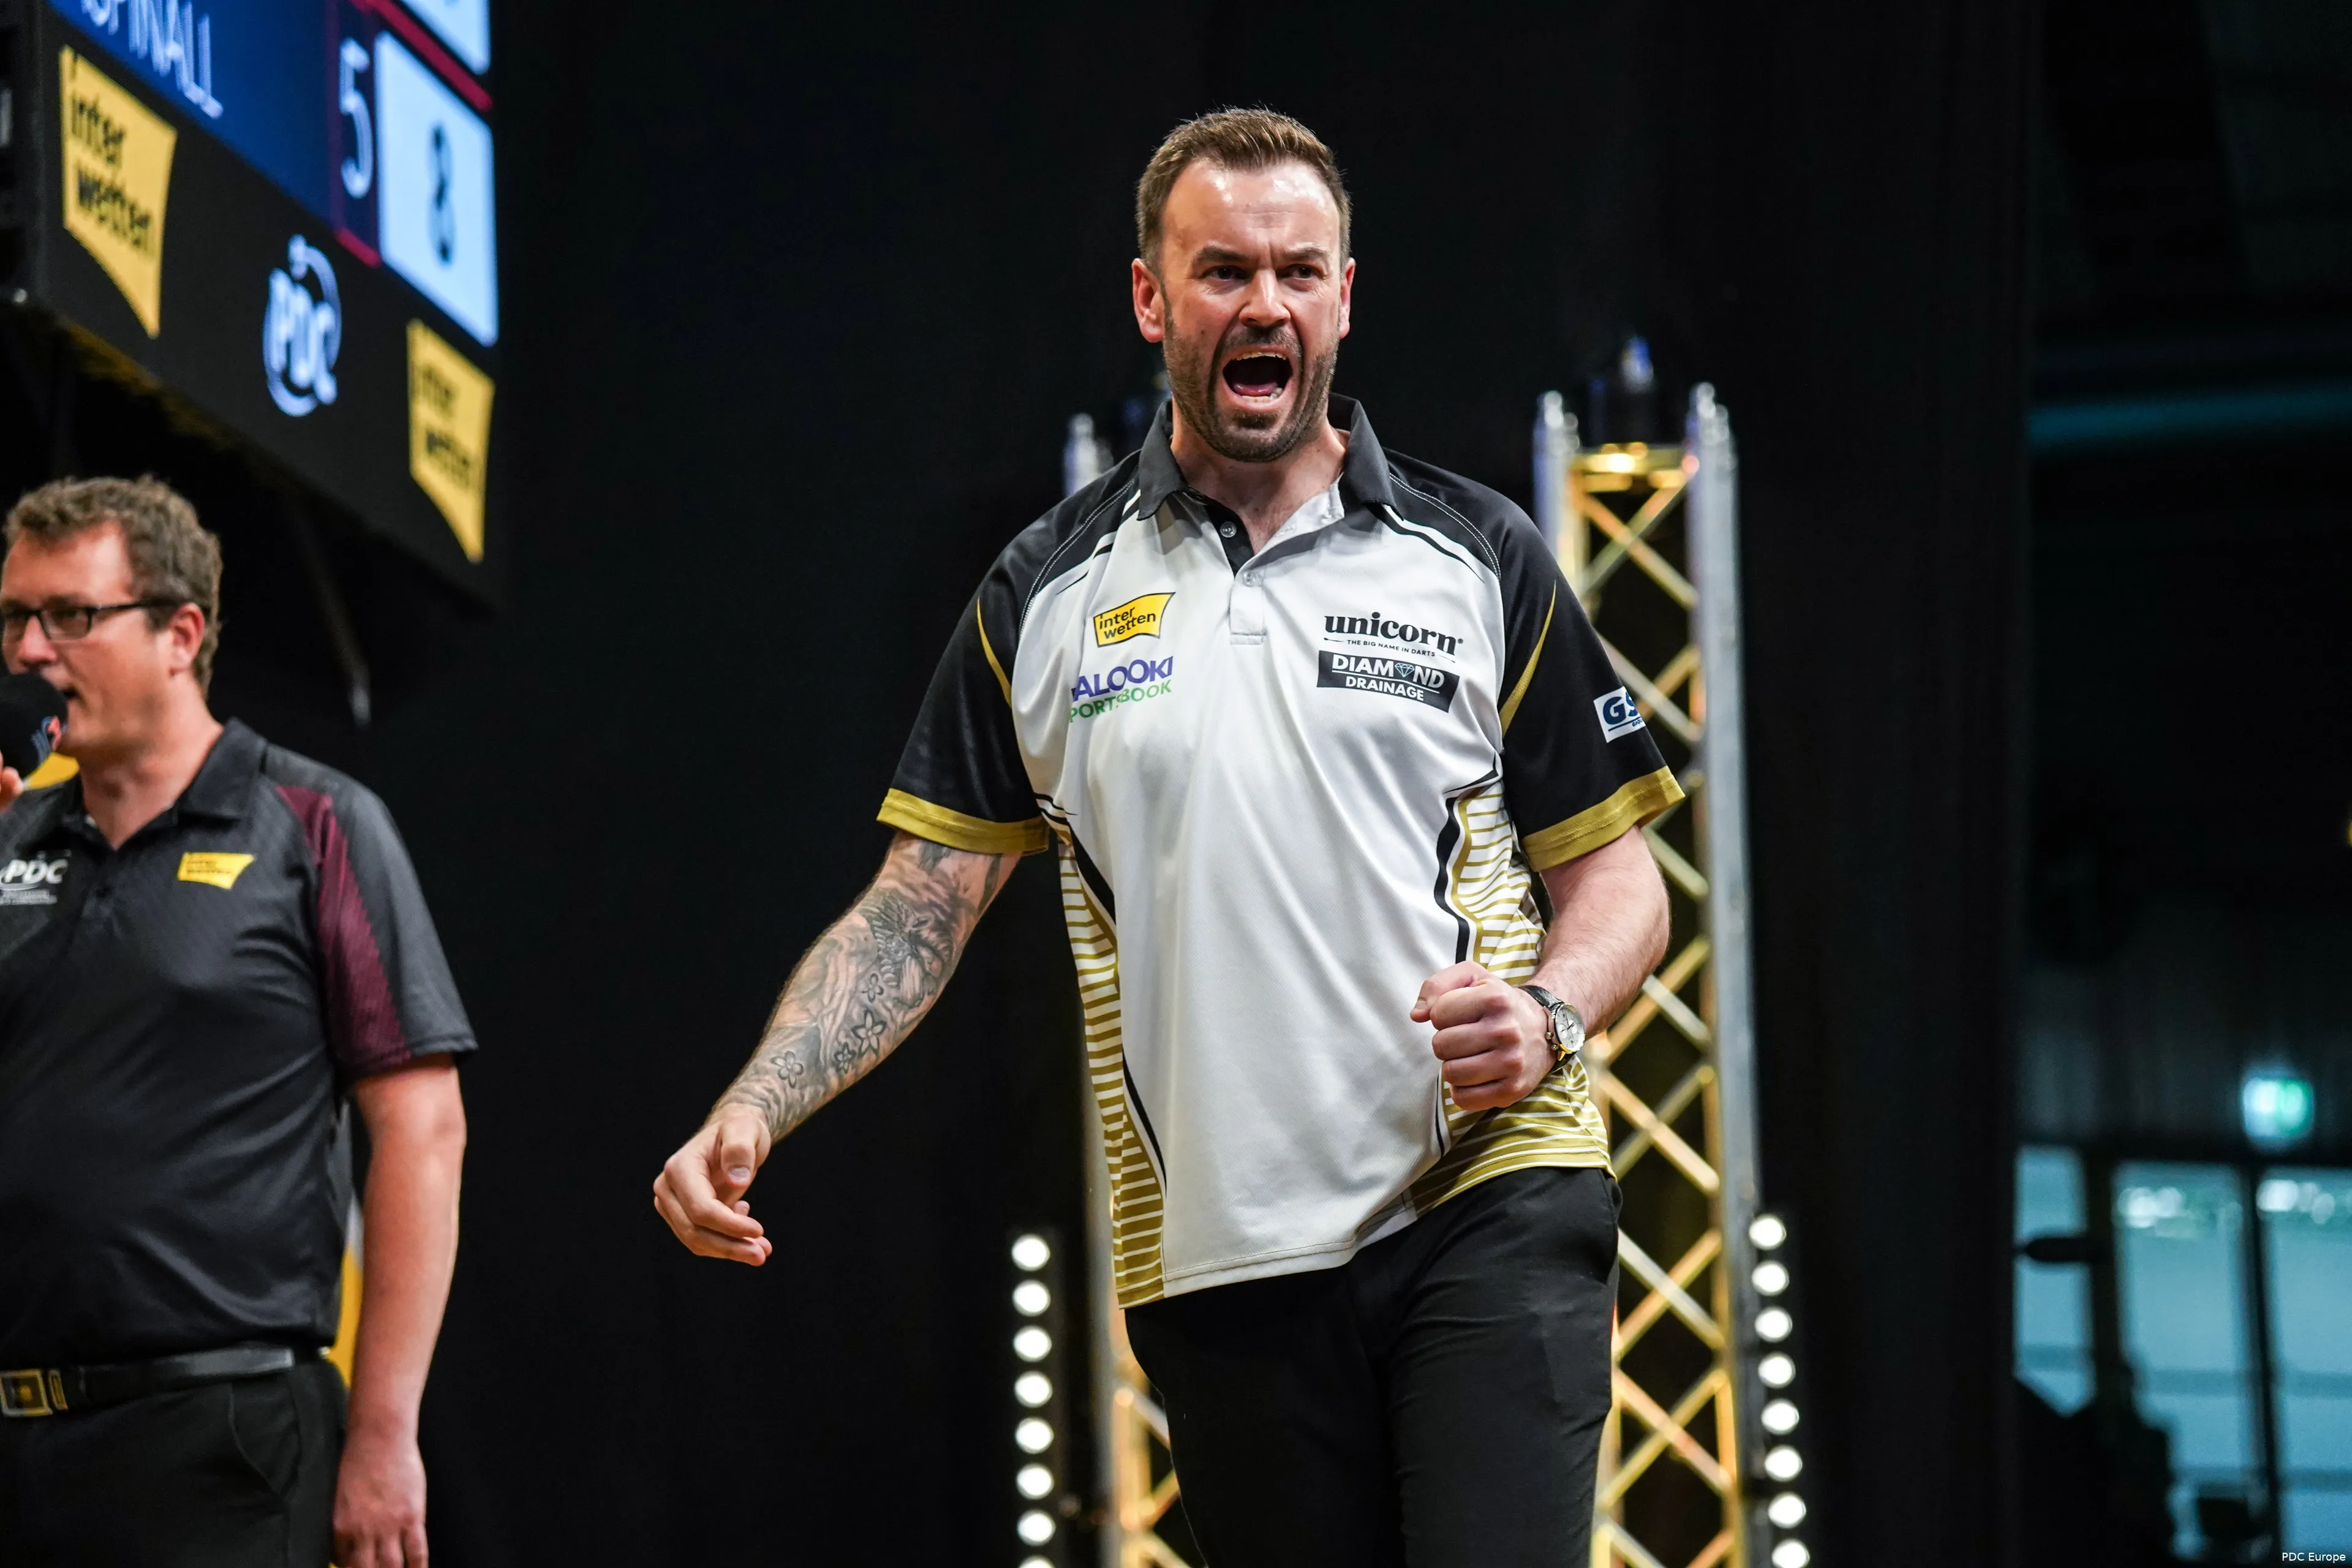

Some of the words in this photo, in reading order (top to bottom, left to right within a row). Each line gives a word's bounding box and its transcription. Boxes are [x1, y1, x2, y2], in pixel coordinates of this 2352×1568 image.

[339, 37, 372, 198] 5
[427, 124, 456, 268] 8
[1099, 607, 1136, 630] inter
[1104, 612, 1156, 639] wetten
[1324, 612, 1456, 655] unicorn
[1071, 656, 1174, 702] ALOOKI
[1346, 676, 1424, 701] DRAINAGE
[4, 859, 68, 884] PDC
